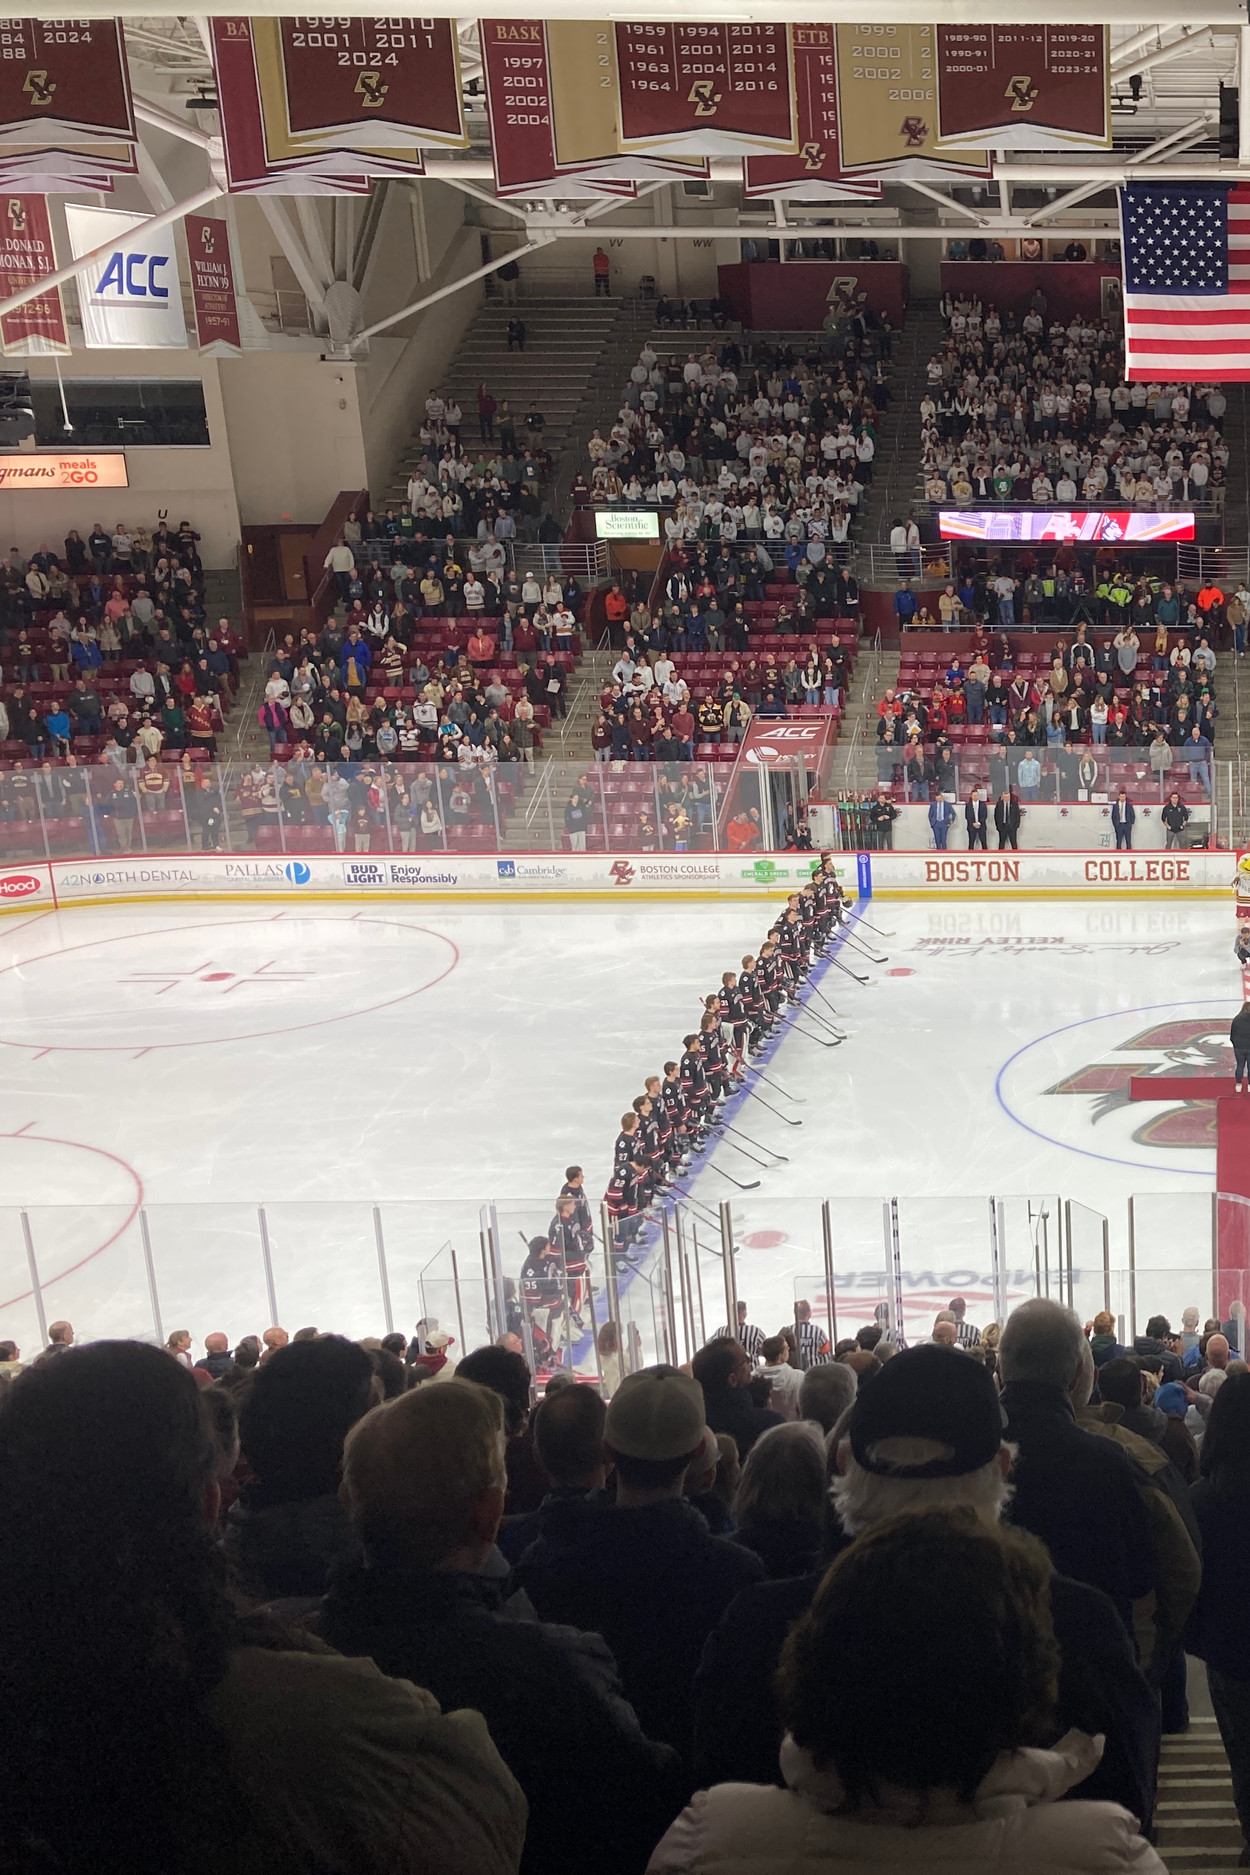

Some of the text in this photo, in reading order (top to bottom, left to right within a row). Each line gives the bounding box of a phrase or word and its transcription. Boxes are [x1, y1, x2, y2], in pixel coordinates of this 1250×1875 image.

[295, 18, 435, 30] 1999 2010
[496, 25, 541, 41] BASK
[625, 24, 775, 37] 1959 1994 2012
[854, 26, 897, 37] 1999
[43, 33, 92, 43] 2024
[292, 33, 434, 49] 2001 2011
[944, 34, 1096, 43] 1989-90 2011-12 2019-20
[627, 43, 776, 55] 1961 2001 2013
[852, 46, 900, 58] 2000
[945, 50, 1096, 59] 1990-91 2020-21
[338, 52, 399, 66] 2024
[503, 57, 543, 69] 1997
[629, 62, 777, 74] 1963 2004 2014
[853, 68, 901, 80] 2002
[945, 65, 1098, 74] 2000-01 2023-24
[503, 76, 543, 88] 2001
[631, 80, 778, 92] 1964 2016
[505, 95, 547, 107] 2002
[6, 239, 44, 252] DONALD
[95, 252, 170, 297] ACC
[59, 459, 96, 470] meals
[61, 471, 98, 483] 2GO
[158, 510, 168, 519] U
[611, 514, 638, 523] Boston
[605, 520, 649, 530] Scientific
[766, 727, 821, 737] ACC
[225, 864, 283, 876] PALLAS
[351, 865, 378, 873] BUD
[391, 865, 421, 876] Enjoy
[517, 866, 565, 877] Cambridge
[925, 860, 1190, 882] BOSTON COLLEGE
[141, 870, 197, 883] DENTAL
[347, 874, 384, 883] LIGHT
[391, 874, 457, 885] Responsibly
[918, 937, 1065, 945] KELLEY RINK
